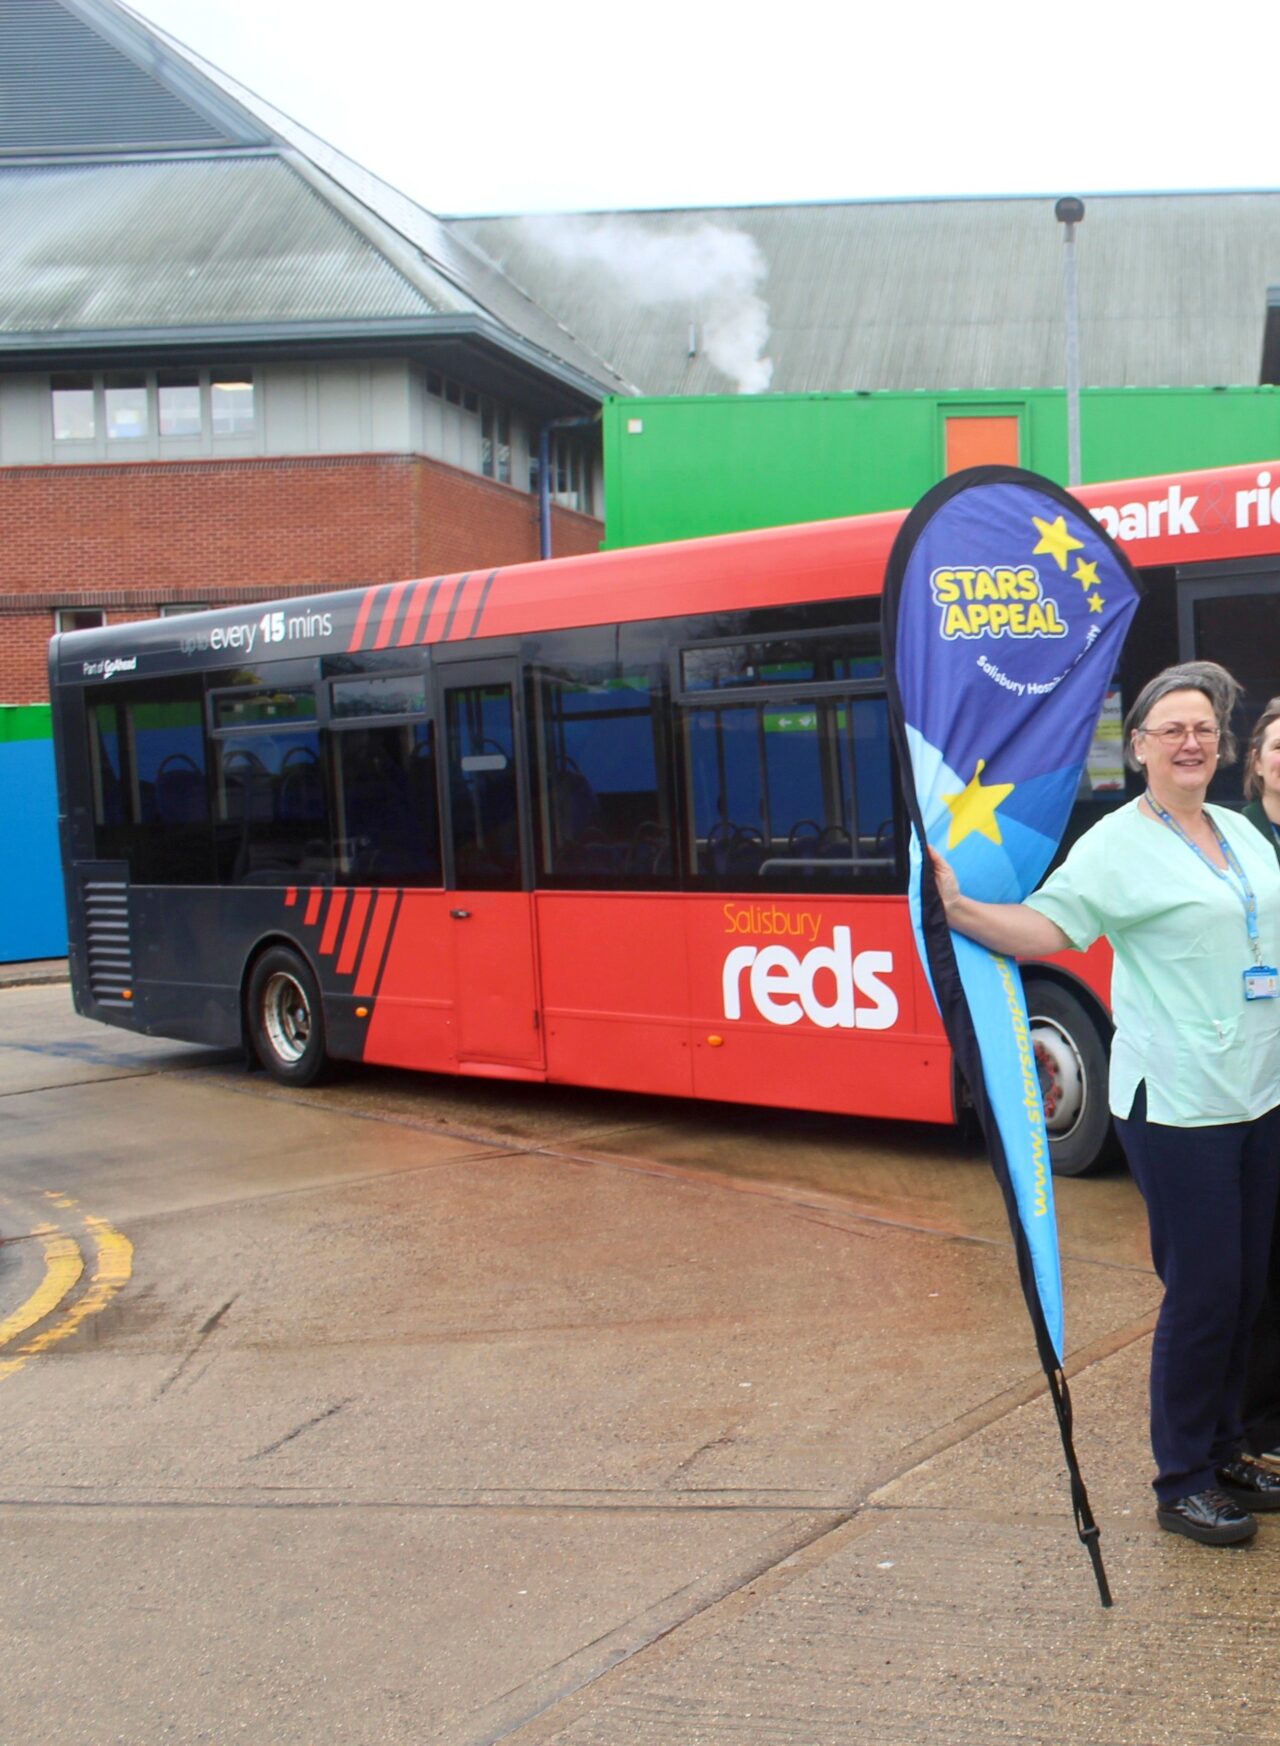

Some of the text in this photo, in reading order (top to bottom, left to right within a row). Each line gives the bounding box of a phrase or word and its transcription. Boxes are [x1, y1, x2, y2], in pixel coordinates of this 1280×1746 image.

[934, 569, 1041, 603] STARS
[209, 622, 257, 653] every
[258, 610, 287, 643] 15
[288, 608, 333, 640] mins
[944, 602, 1066, 636] APPEAL
[976, 655, 1026, 696] Salisbury
[723, 903, 822, 942] Salisbury
[722, 925, 900, 1031] reds
